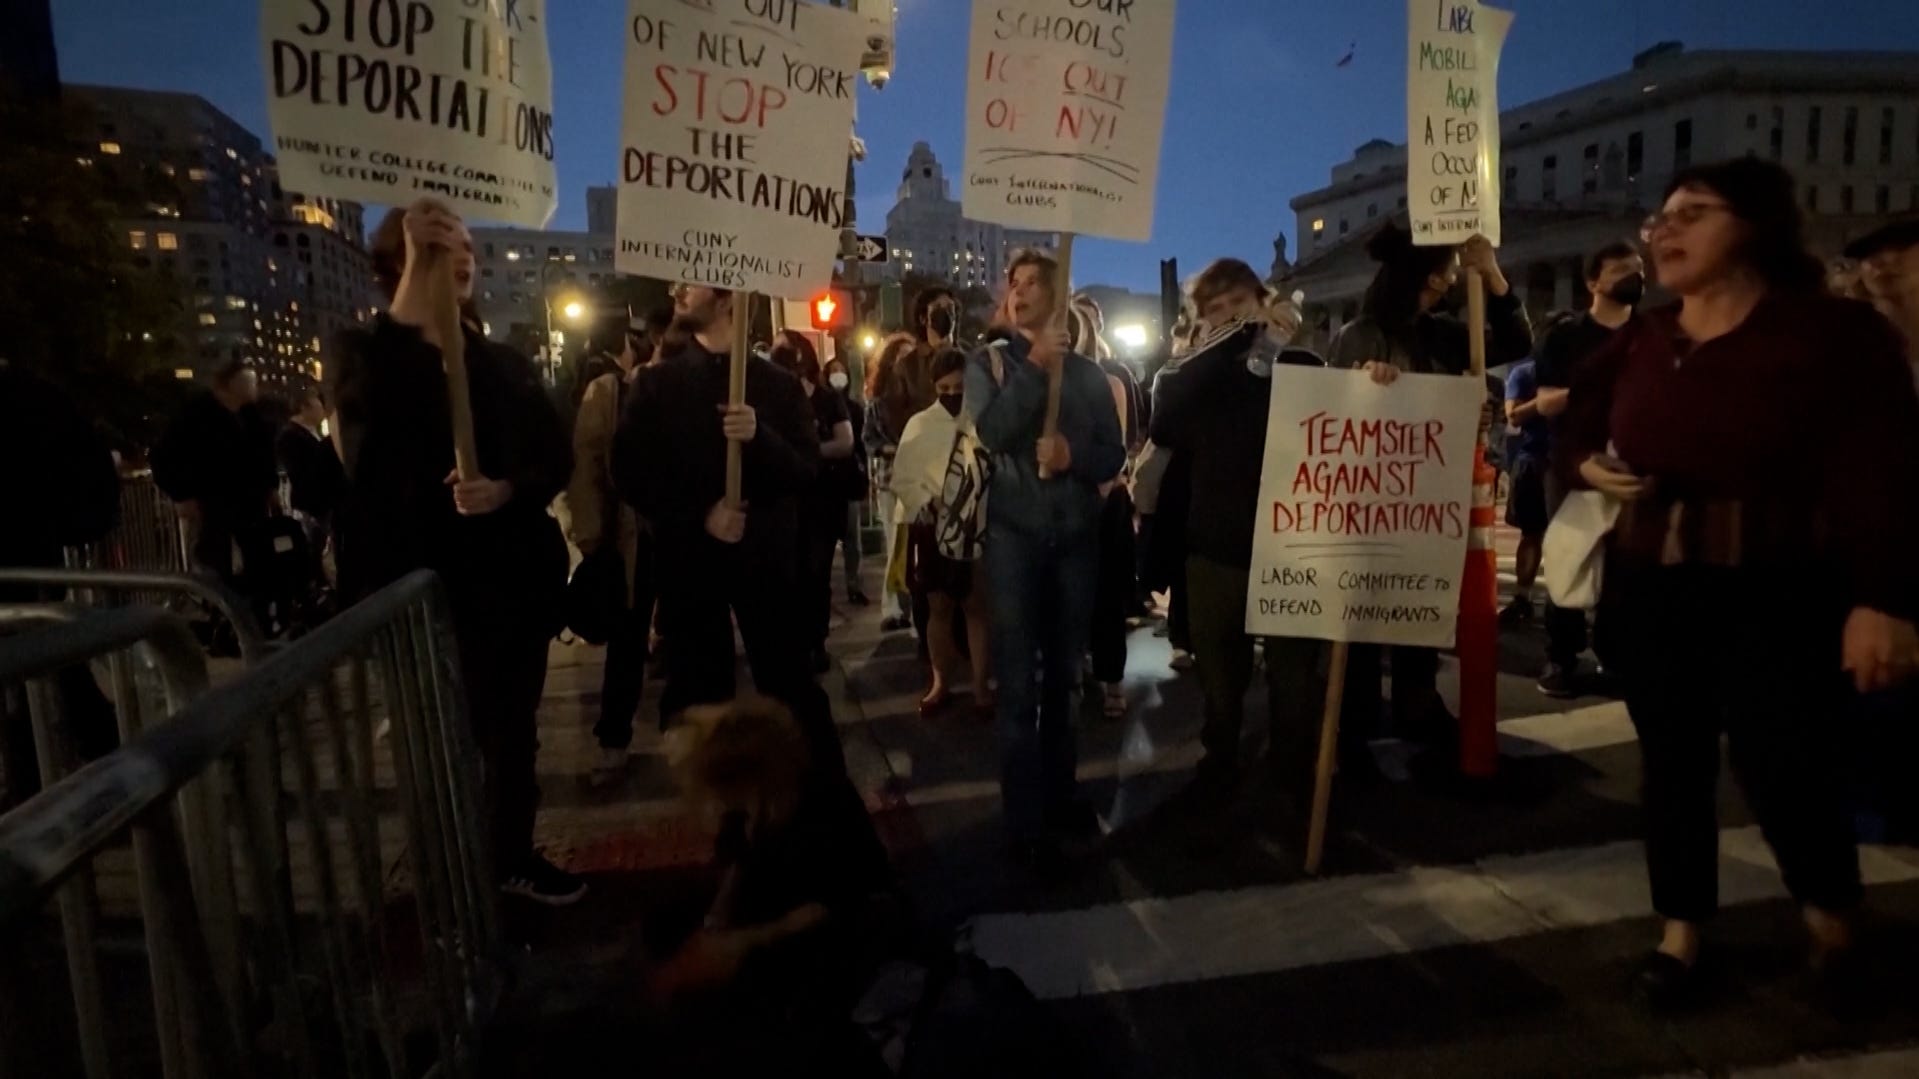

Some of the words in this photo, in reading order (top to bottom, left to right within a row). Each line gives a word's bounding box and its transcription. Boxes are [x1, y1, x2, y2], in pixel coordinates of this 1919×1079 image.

[297, 0, 434, 55] STOP
[633, 15, 677, 51] OF
[697, 31, 766, 68] NEW
[782, 52, 854, 99] YORK
[984, 51, 1040, 83] IC
[1063, 61, 1128, 101] OUT
[271, 39, 554, 161] DEPORTATIONS
[652, 64, 788, 127] STOP
[685, 126, 758, 164] THE
[1056, 104, 1118, 150] NY!
[1424, 115, 1434, 146] A
[1445, 117, 1478, 146] FED
[623, 147, 843, 229] DEPORTATIONS
[1430, 185, 1454, 206] OF
[621, 239, 806, 279] INTERNATIONALIST
[683, 229, 738, 248] CUNY
[681, 266, 746, 288] CLUBS
[1300, 411, 1445, 466] TEAMSTER
[1292, 460, 1424, 502] AGAINST
[1273, 500, 1464, 540] DEPORTATIONS
[1261, 566, 1318, 587] LABOR
[1338, 569, 1430, 593] COMMITTEE
[1259, 599, 1322, 617] DEFEND
[1342, 603, 1440, 625] IMMIGRANTS
